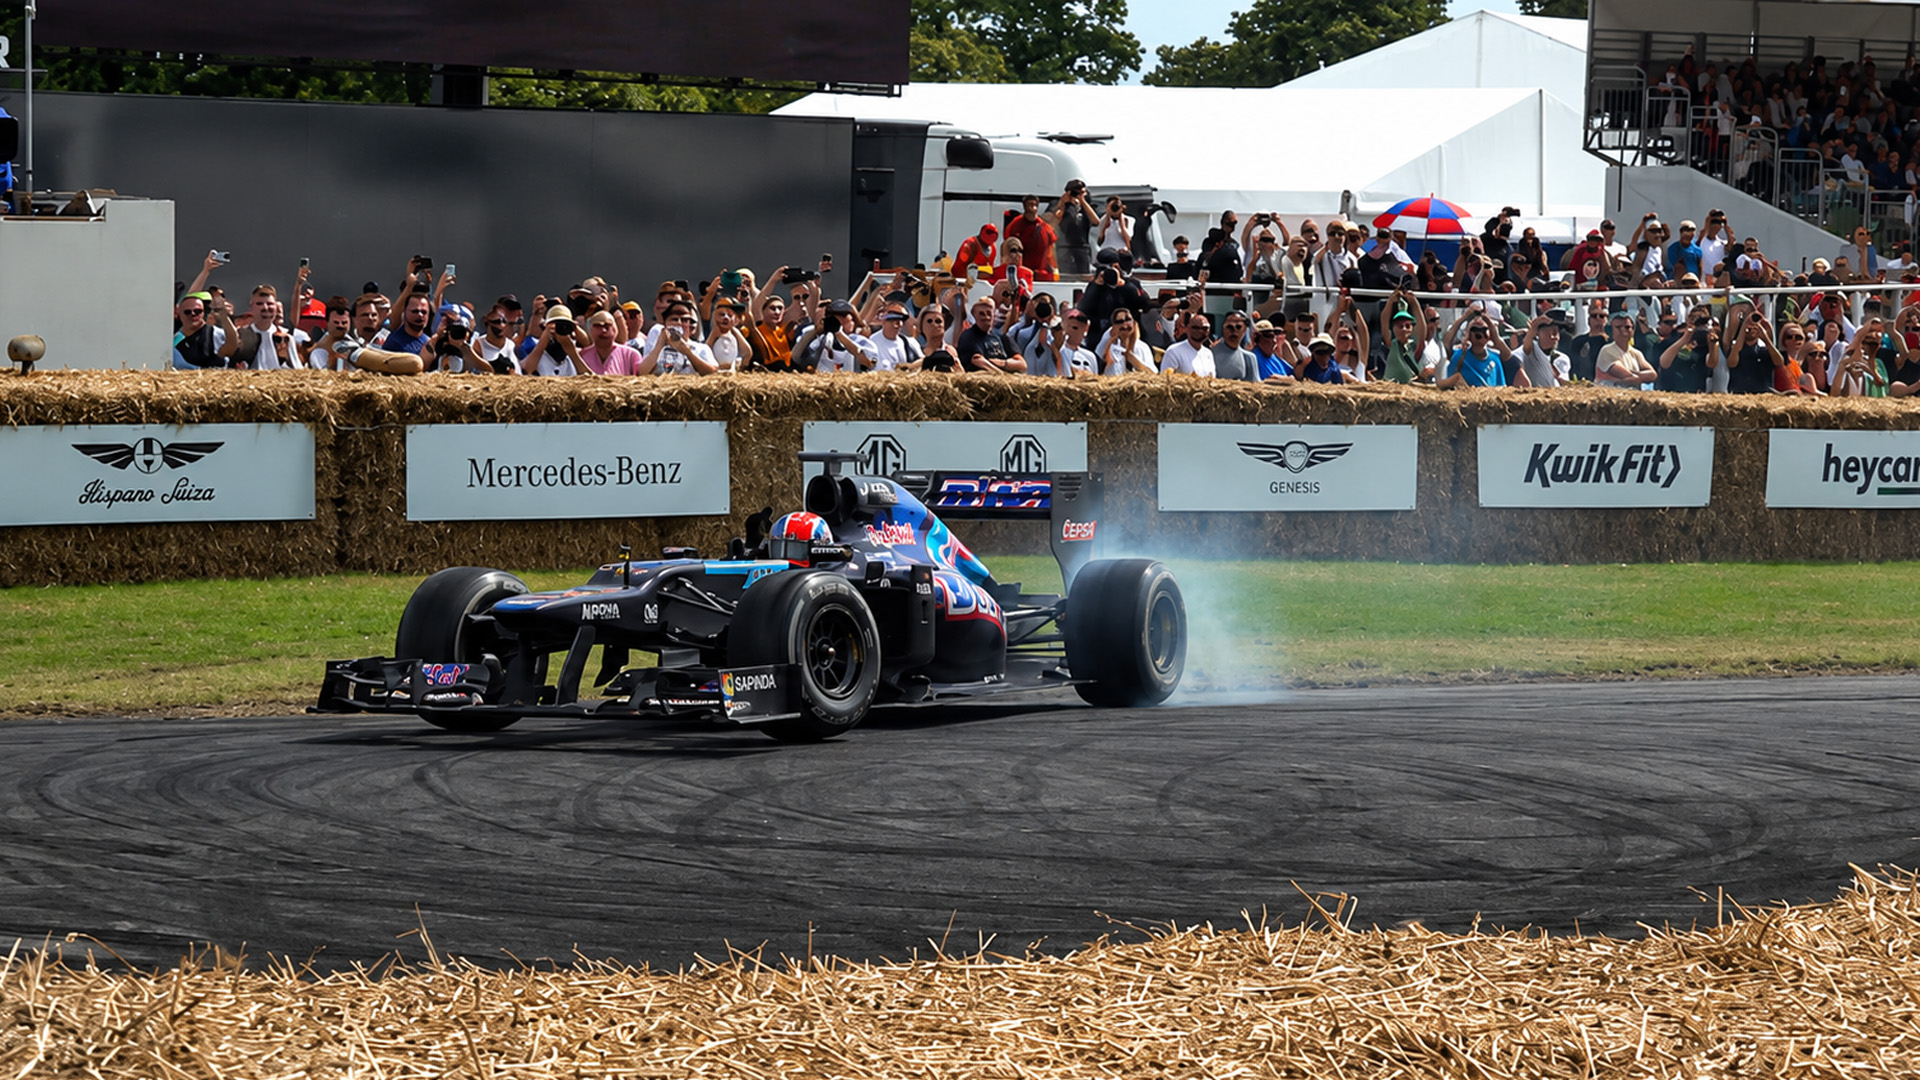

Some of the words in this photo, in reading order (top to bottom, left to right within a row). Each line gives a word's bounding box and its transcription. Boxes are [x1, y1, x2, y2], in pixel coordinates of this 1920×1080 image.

[467, 456, 682, 487] Mercedes-Benz
[860, 440, 901, 476] MG
[1005, 440, 1042, 472] MG
[79, 478, 155, 509] Hispano
[161, 477, 216, 504] Suiza
[1269, 481, 1321, 494] GENESIS
